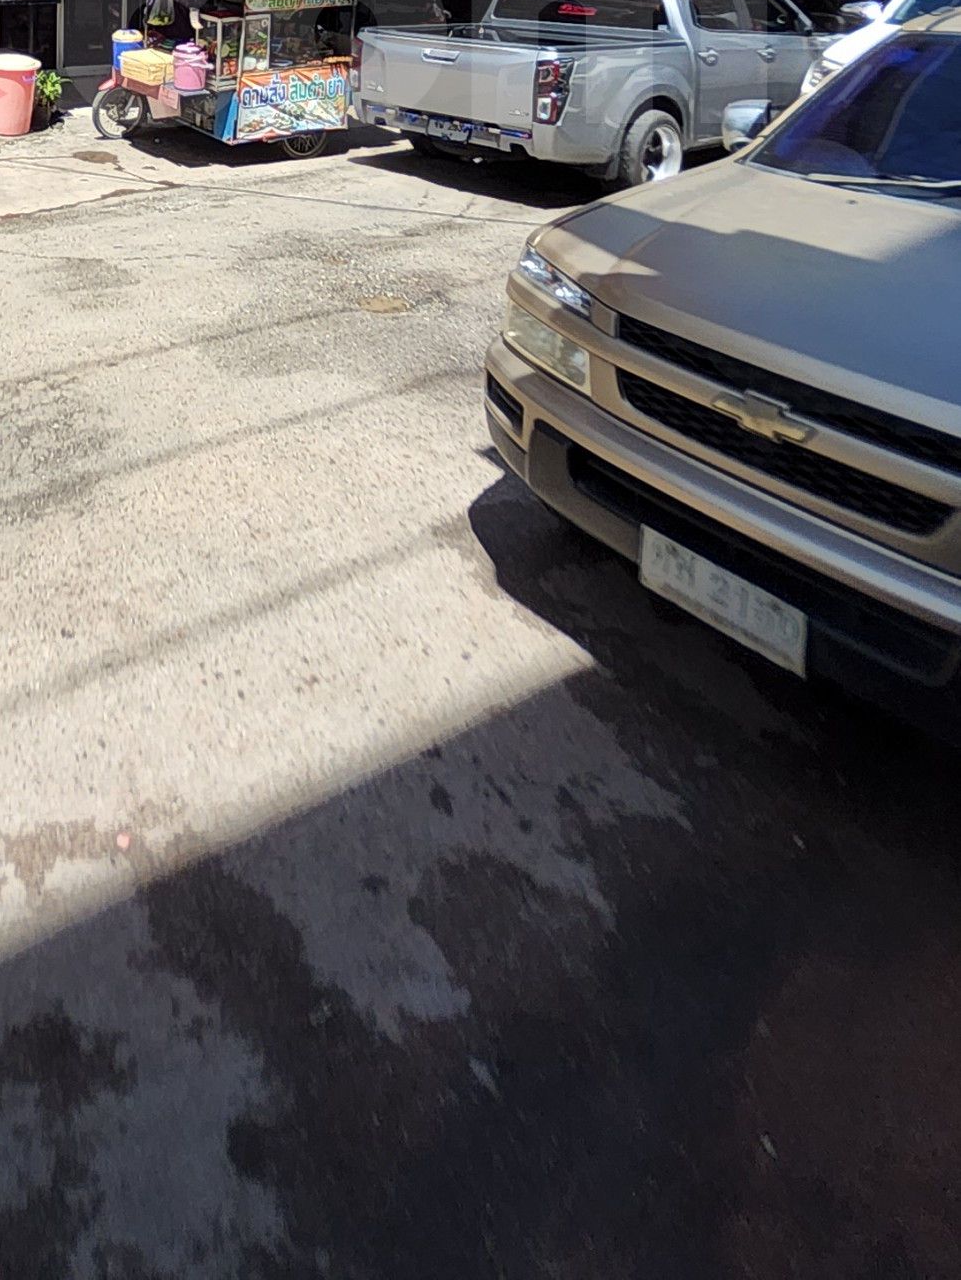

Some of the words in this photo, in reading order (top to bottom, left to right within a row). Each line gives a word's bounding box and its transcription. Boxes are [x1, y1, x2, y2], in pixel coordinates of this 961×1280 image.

[242, 74, 286, 107] ตามสั่ง
[289, 76, 325, 102] ส้มตำ
